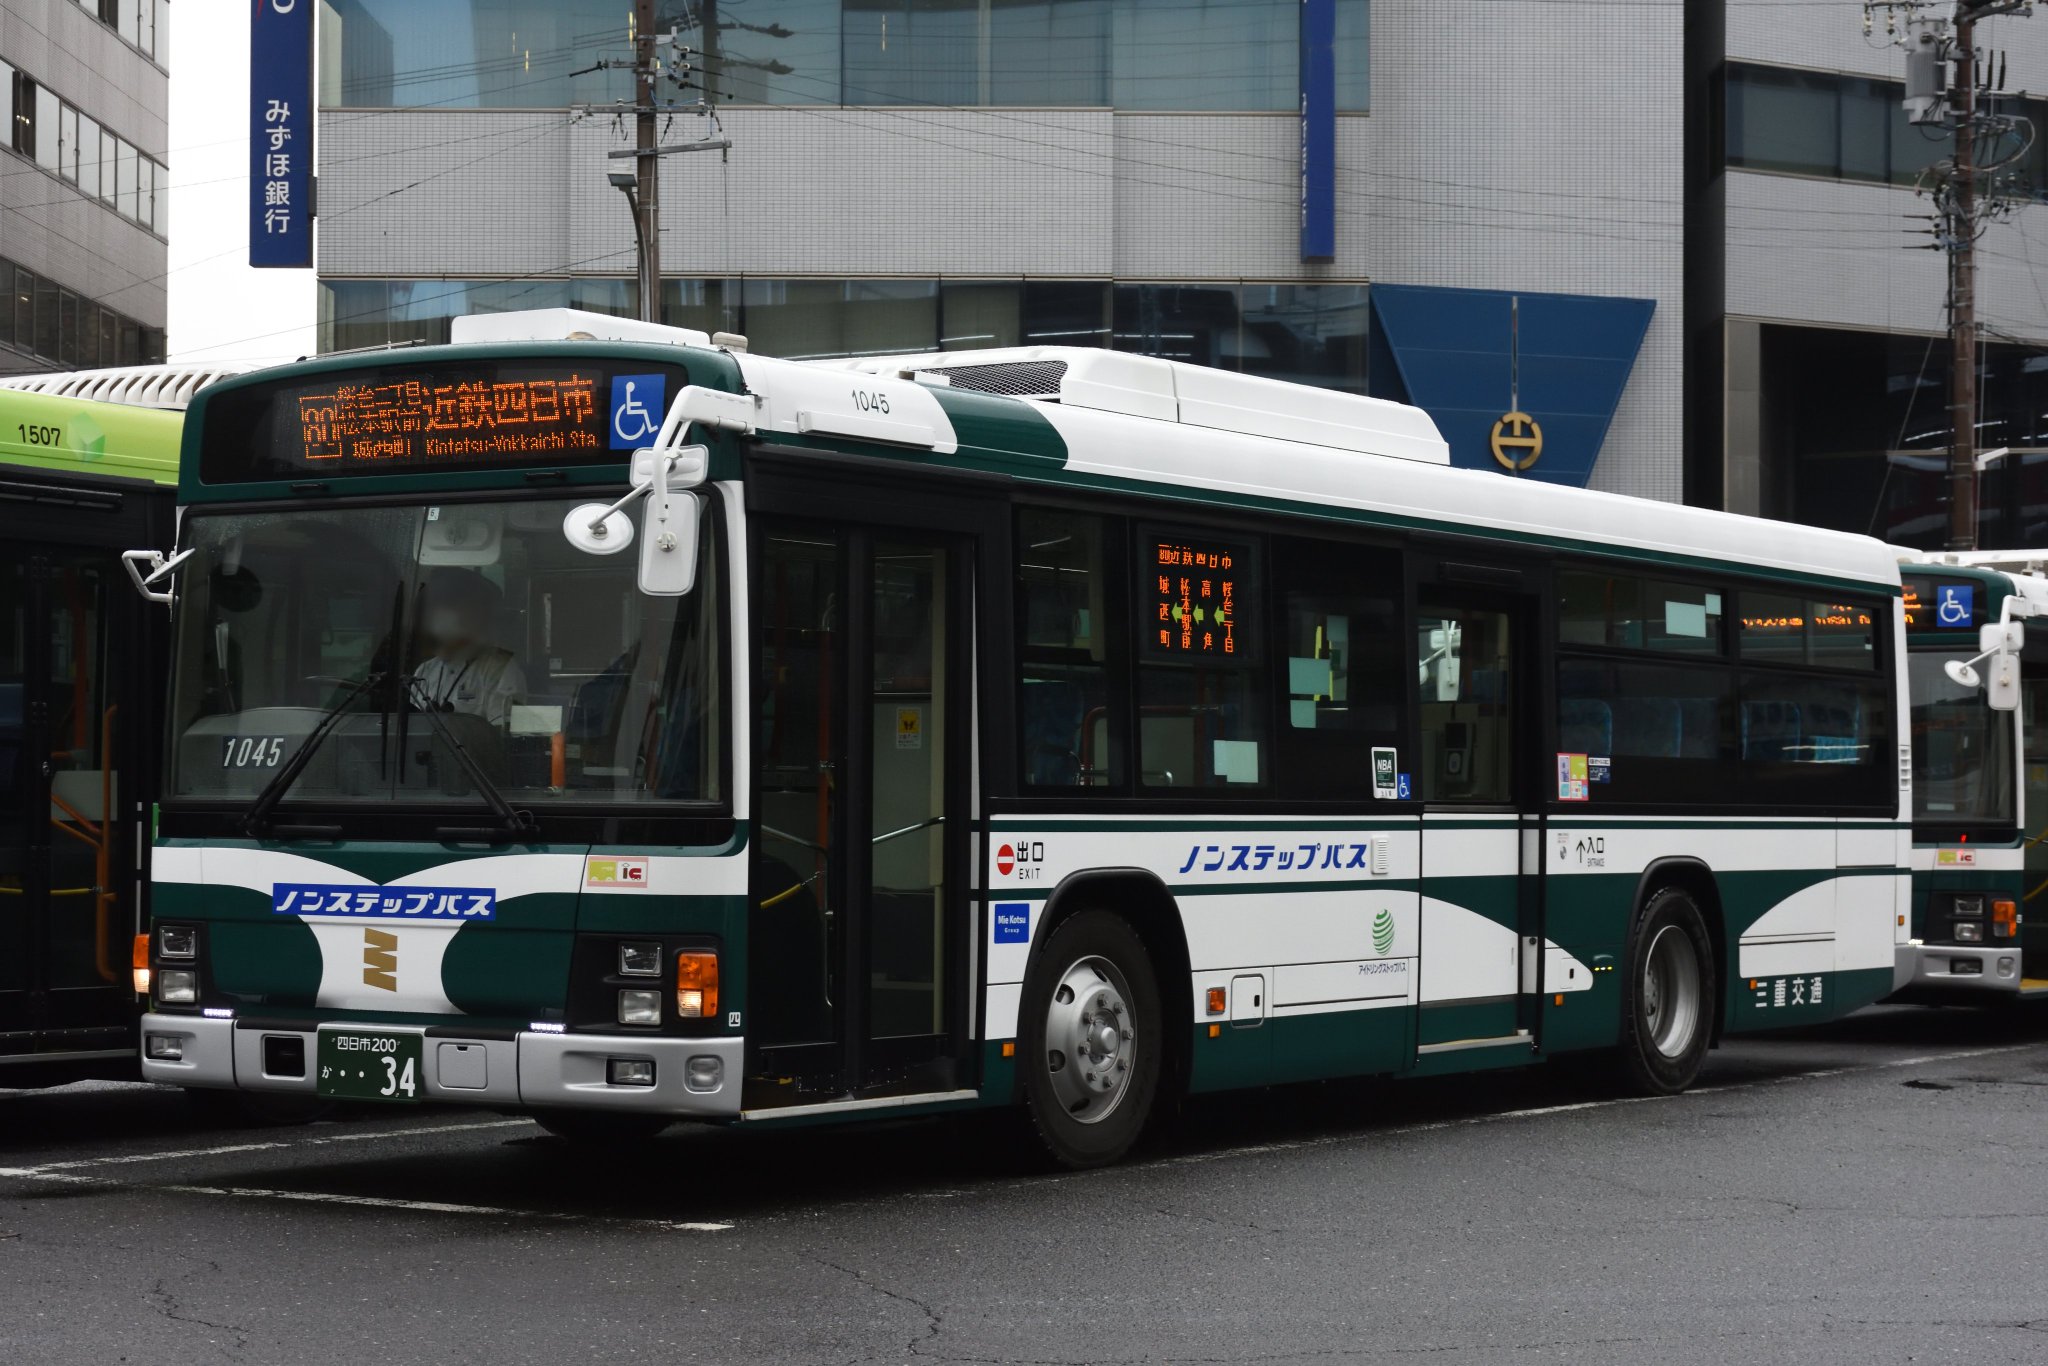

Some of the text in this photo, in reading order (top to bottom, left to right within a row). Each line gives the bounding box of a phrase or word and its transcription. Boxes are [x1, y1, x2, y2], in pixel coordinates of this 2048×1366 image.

[265, 99, 291, 234] みずほ銀行
[422, 373, 593, 432] 近鉄四日市
[852, 389, 890, 415] 1045
[18, 424, 61, 446] 1507
[223, 737, 284, 767] 1045
[1377, 759, 1392, 771] NBA
[1016, 841, 1044, 863] 出口
[1586, 836, 1605, 854] 入口
[1179, 842, 1367, 874] ノンステップバス
[1019, 868, 1041, 880] EXIT
[275, 891, 493, 916] ノンステップバス
[998, 915, 1026, 925] Mie Kotsu
[1755, 976, 1823, 1008] 三重交通
[321, 1066, 333, 1079] か
